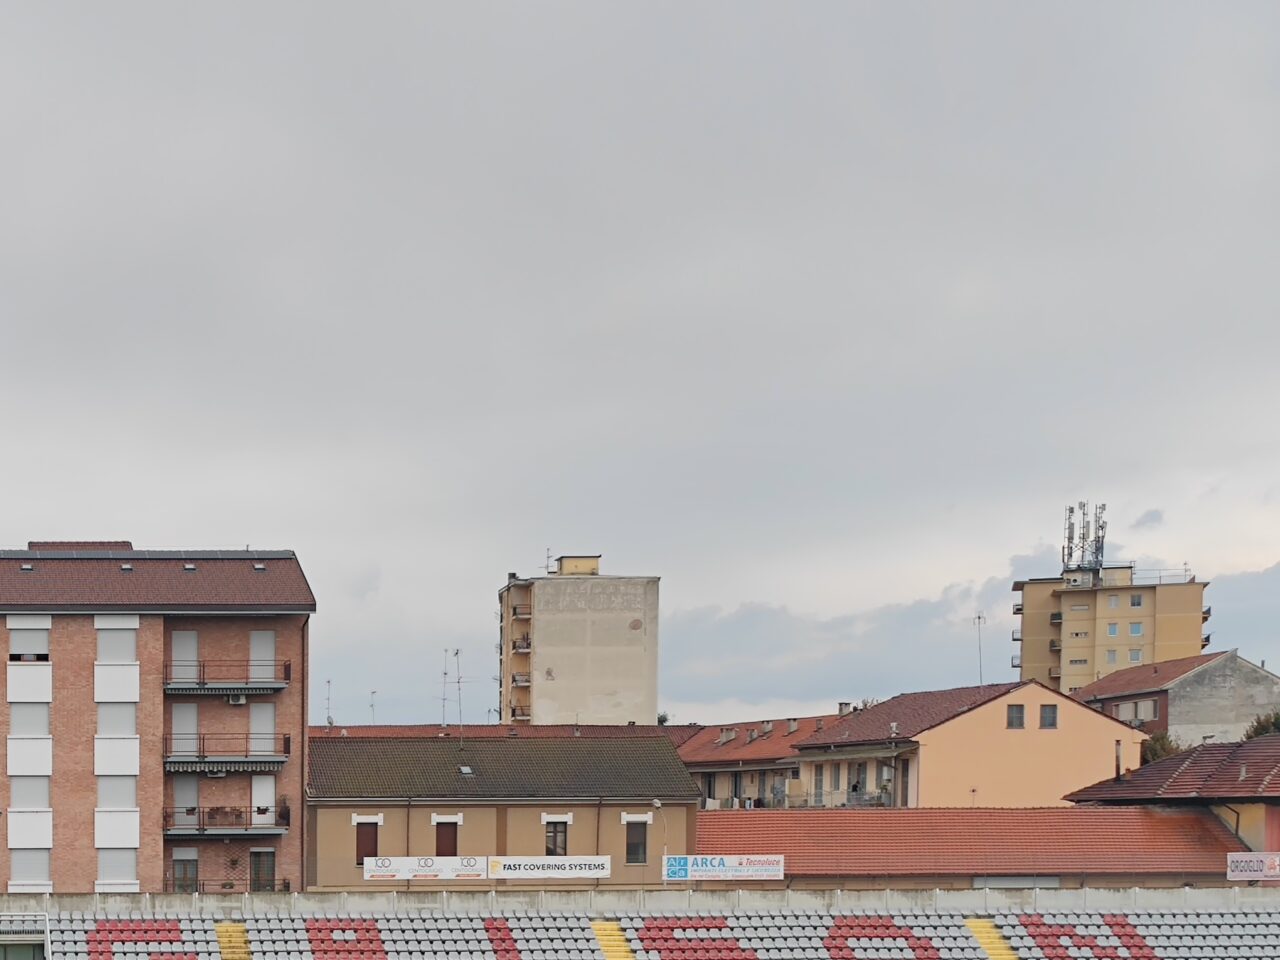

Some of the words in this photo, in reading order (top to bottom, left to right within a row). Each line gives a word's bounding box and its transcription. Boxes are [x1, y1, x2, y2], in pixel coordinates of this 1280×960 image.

[691, 857, 726, 868] ARCA
[745, 858, 780, 866] Tecnoluce
[1231, 859, 1264, 873] ORGOGLIO
[503, 863, 522, 871] FAST
[523, 863, 567, 871] COVERING
